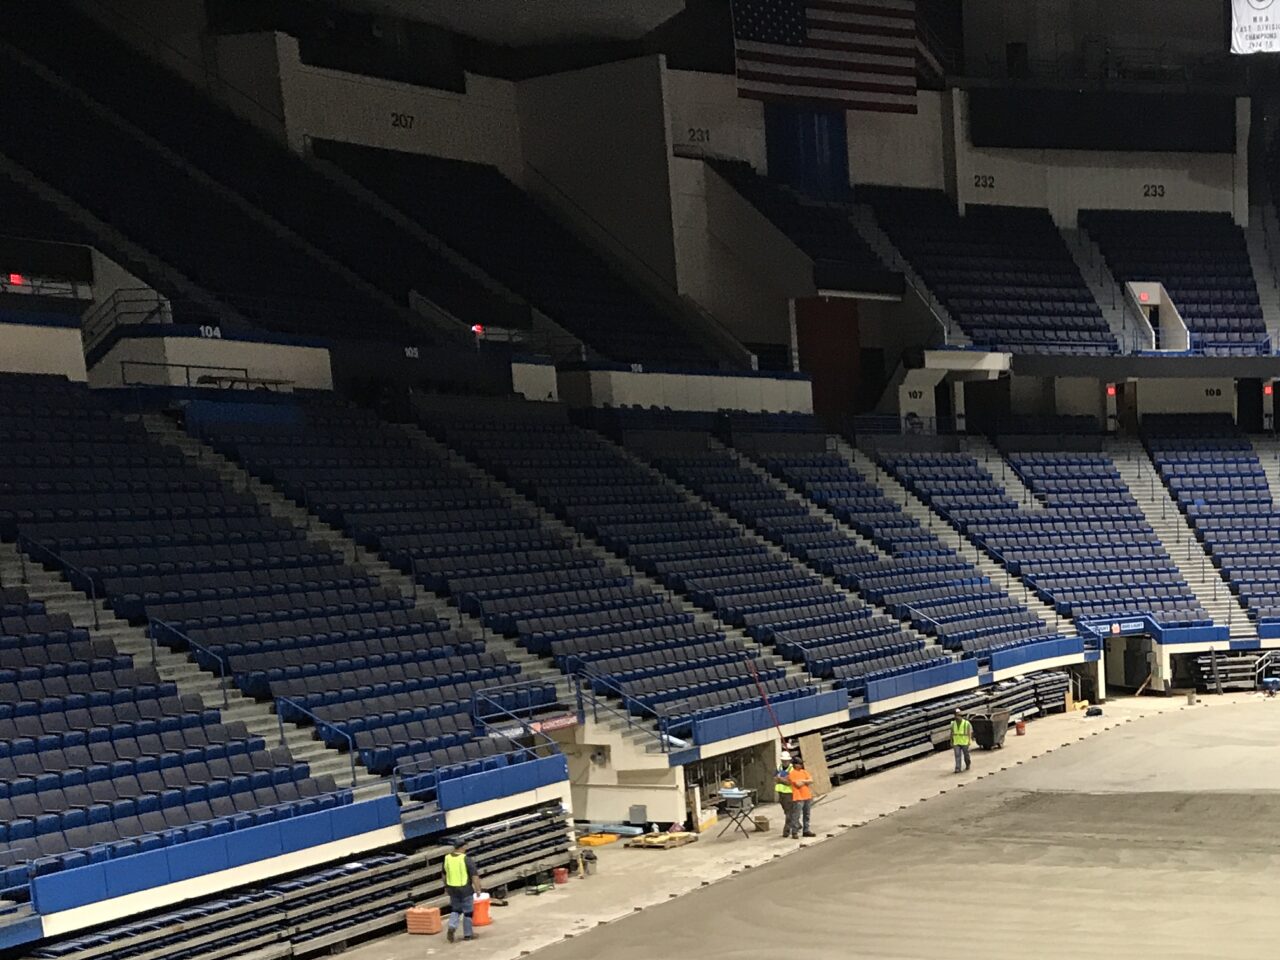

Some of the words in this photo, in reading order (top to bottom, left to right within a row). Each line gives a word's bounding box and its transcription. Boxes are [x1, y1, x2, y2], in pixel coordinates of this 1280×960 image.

[391, 112, 414, 129] 207
[688, 128, 710, 142] 231
[974, 175, 995, 188] 232
[1143, 184, 1165, 197] 233
[199, 325, 221, 339] 104
[908, 389, 923, 400] 107
